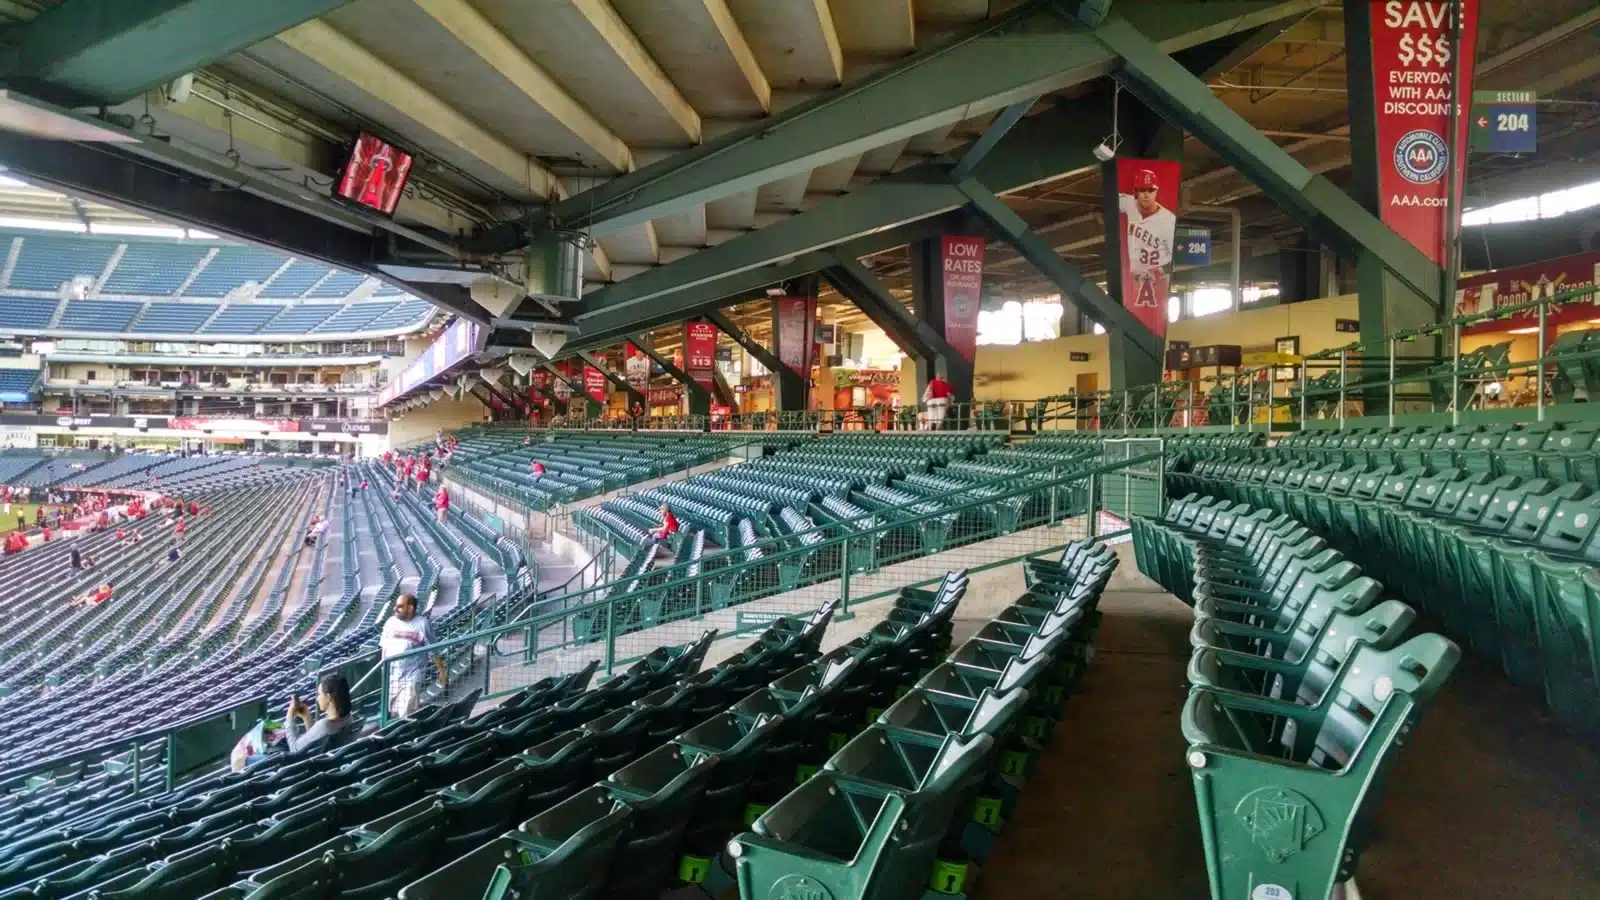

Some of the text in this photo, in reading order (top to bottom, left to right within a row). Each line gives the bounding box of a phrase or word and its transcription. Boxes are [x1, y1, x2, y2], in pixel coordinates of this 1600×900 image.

[1389, 70, 1452, 84] EVERYDA
[1388, 86, 1420, 99] WITH
[1497, 113, 1529, 131] 204
[1409, 148, 1433, 162] AAA
[949, 243, 979, 257] LOW
[1188, 242, 1207, 254] 204
[1140, 249, 1160, 266] 32
[944, 258, 982, 273] RATES
[691, 358, 711, 366] 113
